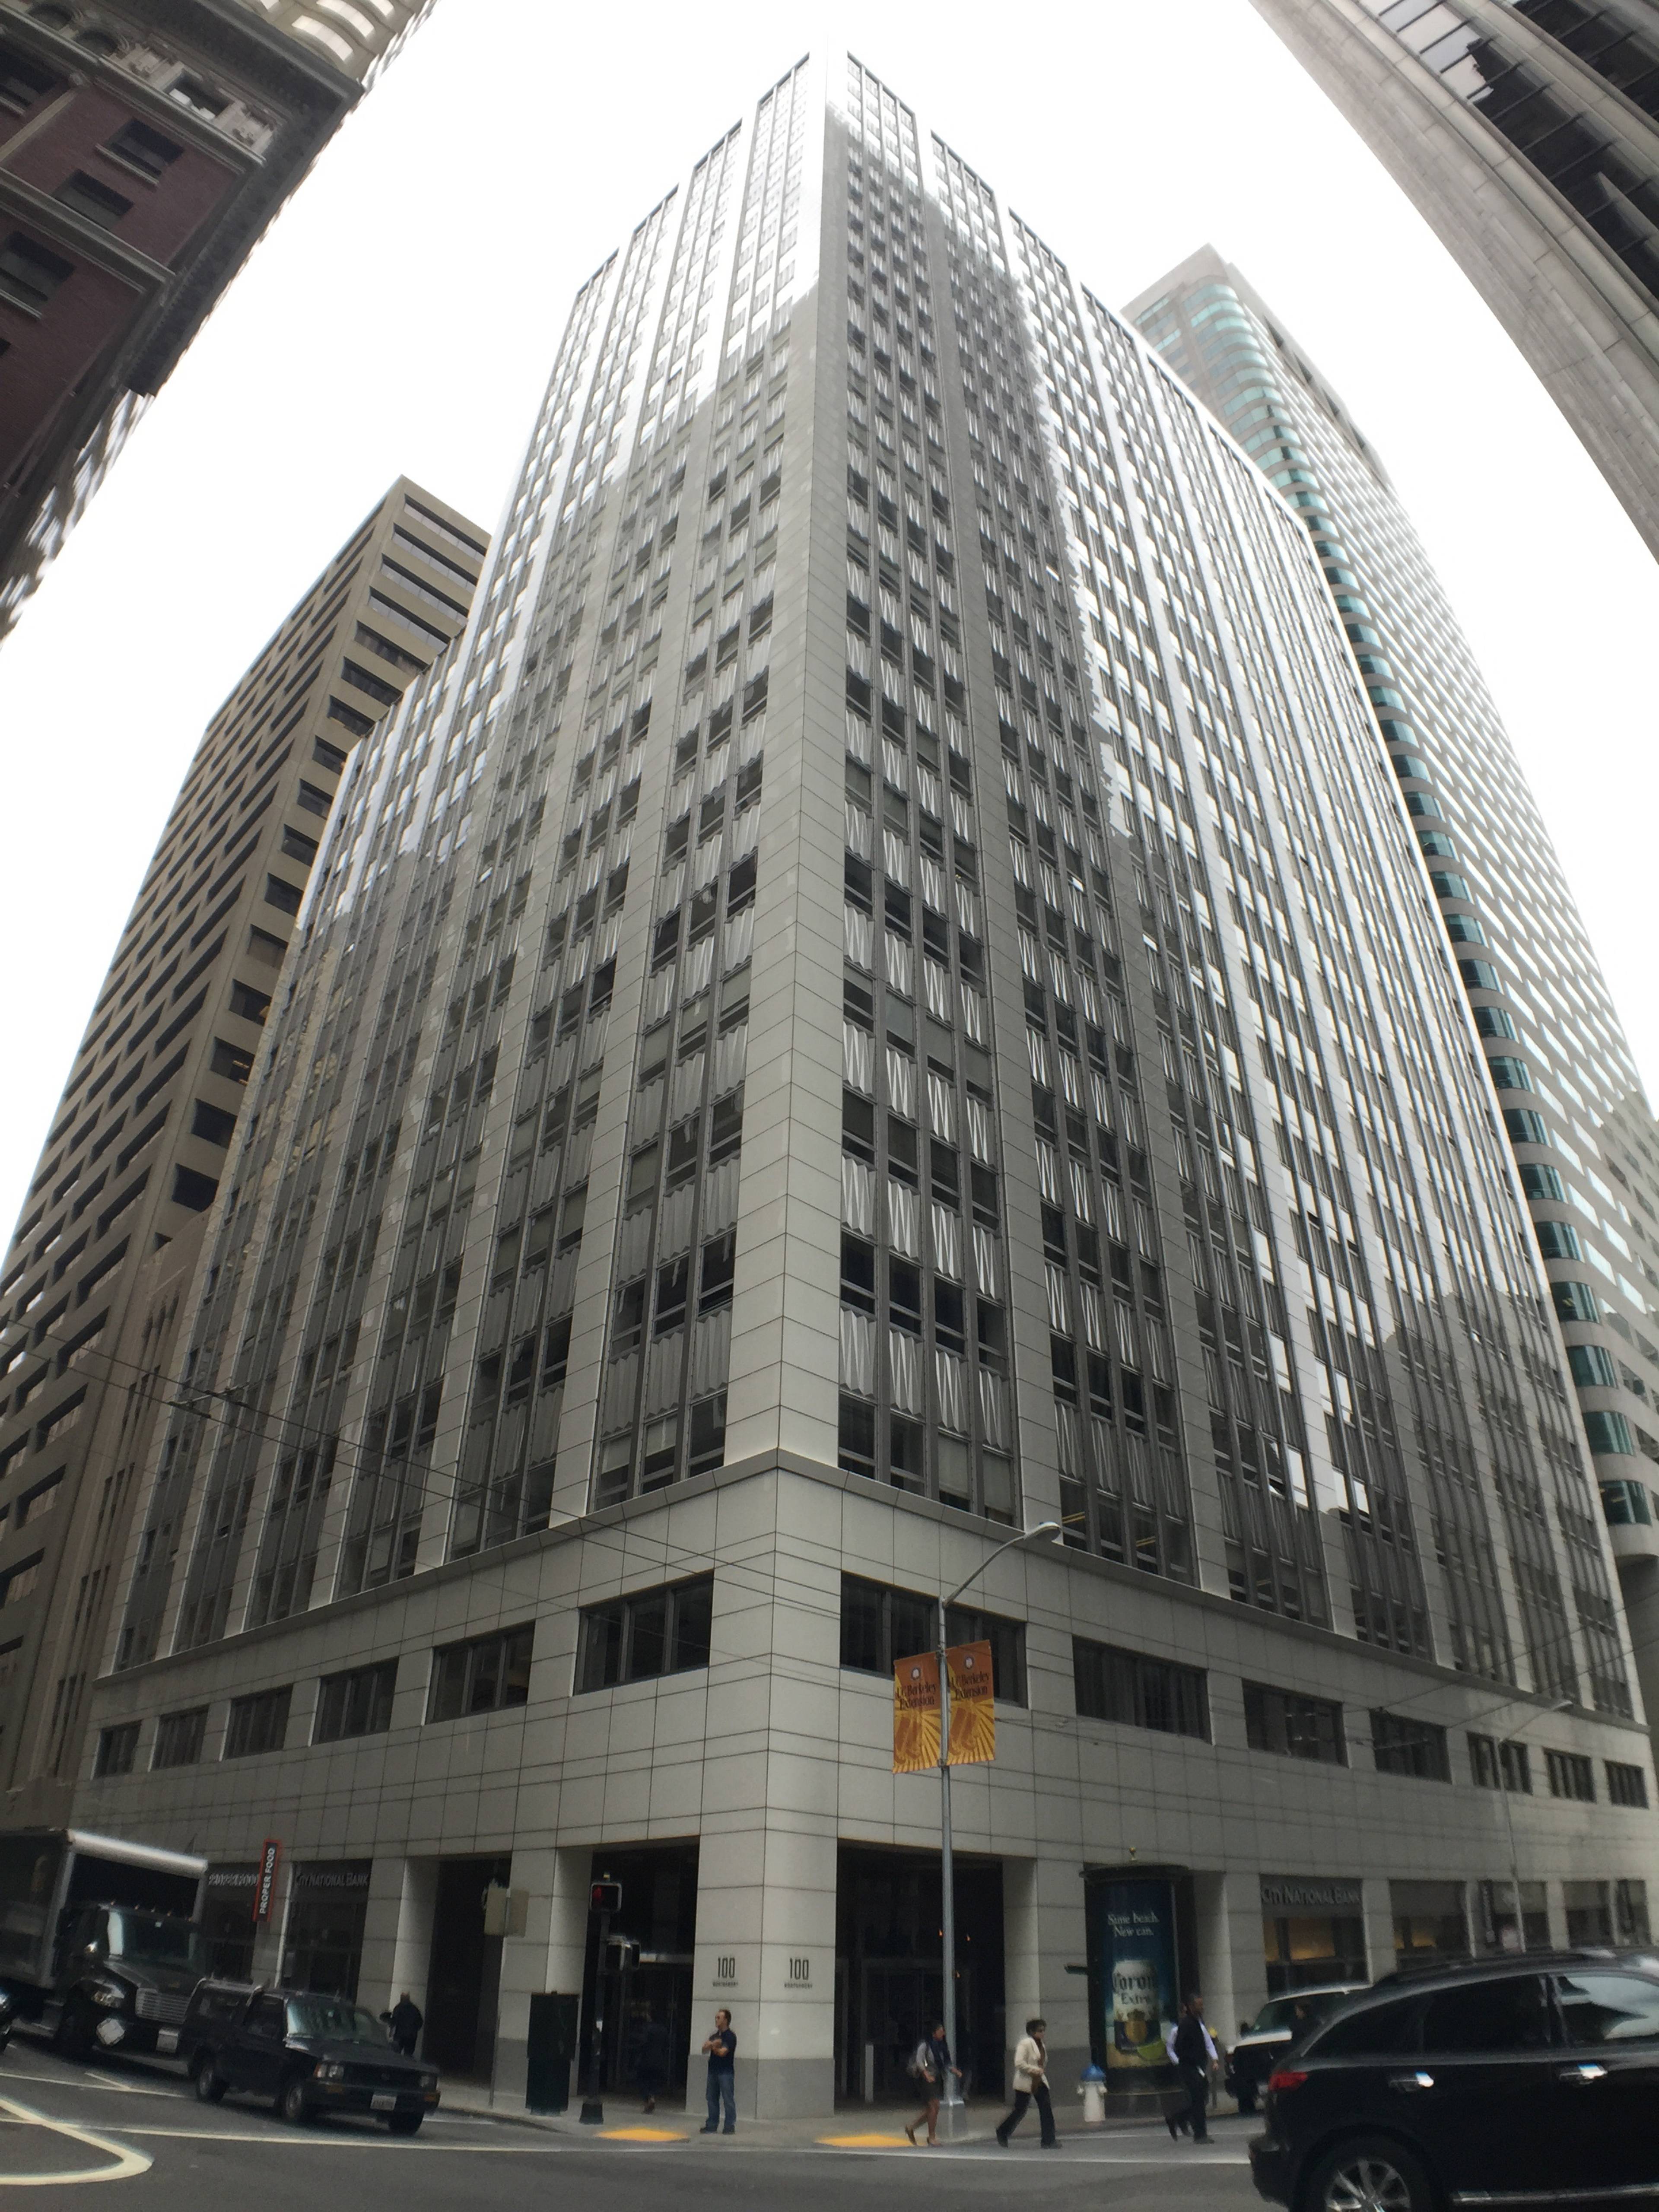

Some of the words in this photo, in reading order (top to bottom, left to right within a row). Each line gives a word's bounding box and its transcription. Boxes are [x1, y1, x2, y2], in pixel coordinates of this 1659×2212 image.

[961, 1671, 989, 1686] Berkeley
[908, 1681, 936, 1696] Berkeley
[955, 1685, 988, 1700] Extension
[900, 1695, 934, 1710] Extension
[264, 1847, 275, 1873] FOOD
[311, 1874, 345, 1887] NATIONAL
[346, 1873, 369, 1887] BANK
[259, 1875, 271, 1914] PROPER
[718, 1957, 735, 1978] 100
[790, 1958, 809, 1980] 100
